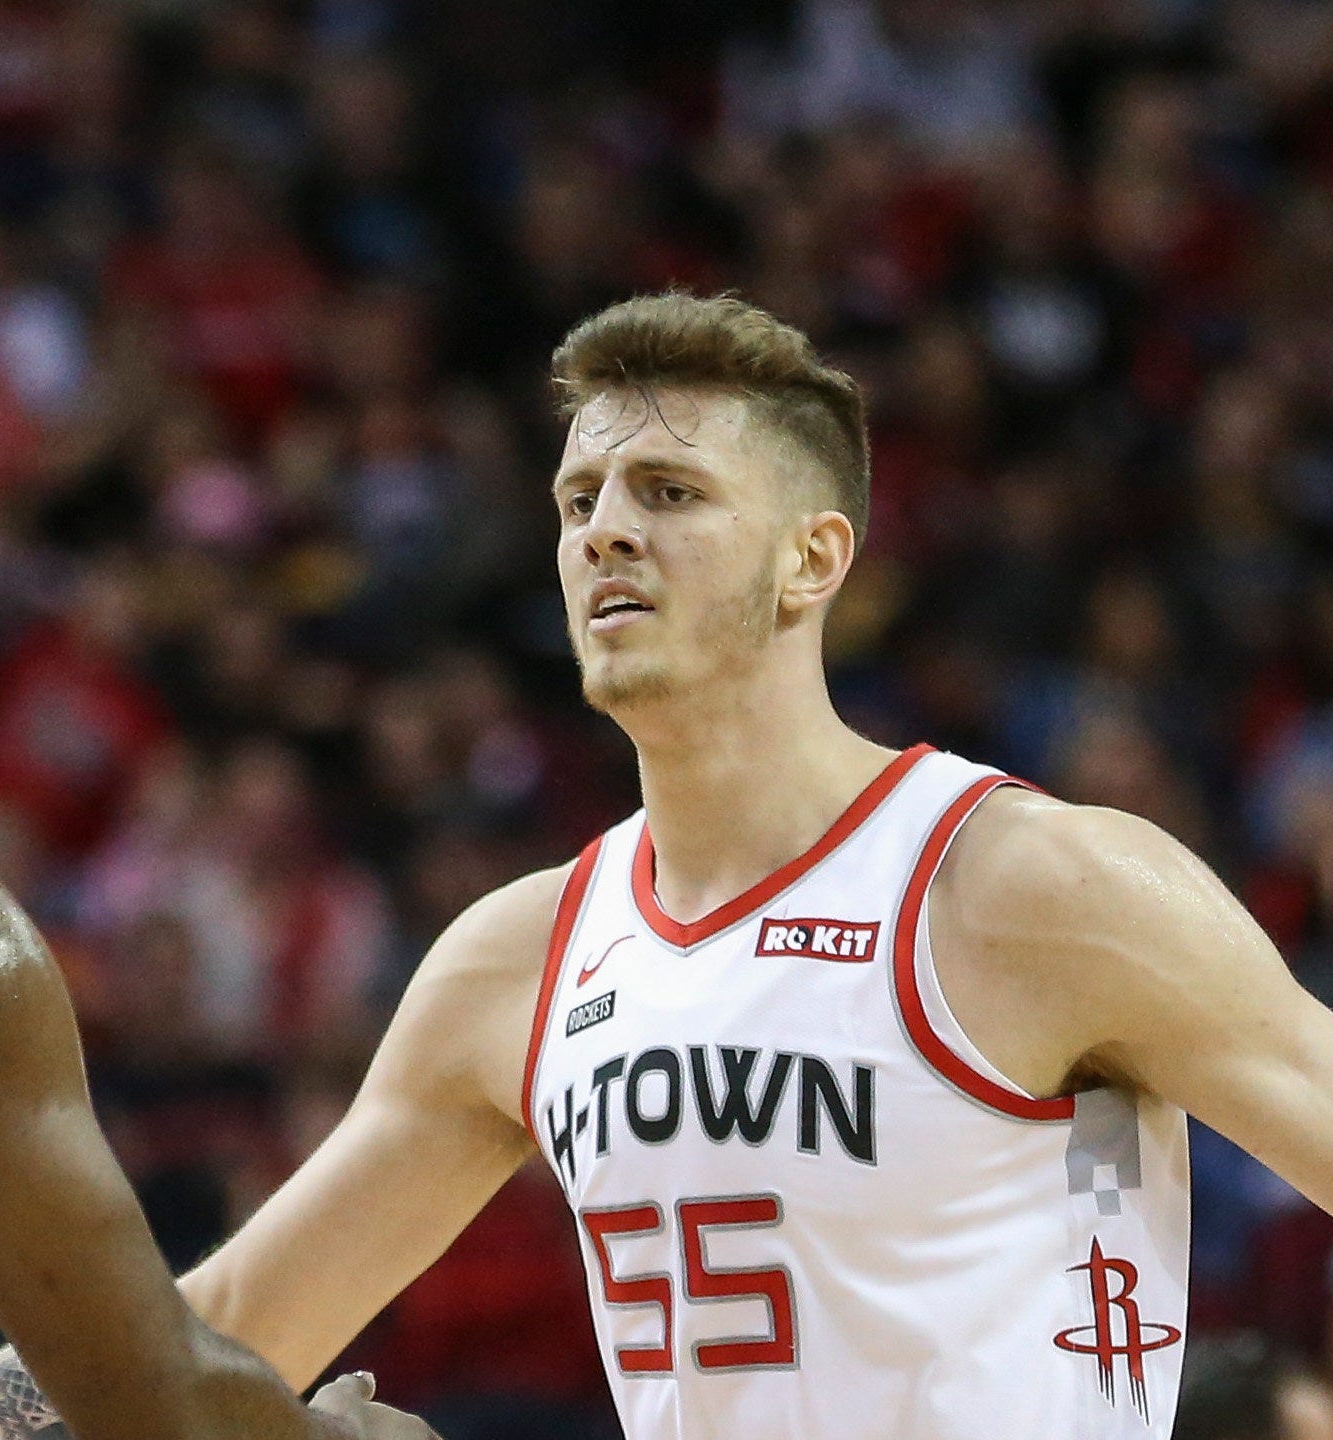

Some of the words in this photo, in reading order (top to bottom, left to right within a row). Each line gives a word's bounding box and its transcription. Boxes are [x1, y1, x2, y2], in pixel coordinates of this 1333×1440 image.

[568, 994, 612, 1034] ROCKETS
[546, 1044, 877, 1186] H-TOWN
[579, 1192, 800, 1379] 55
